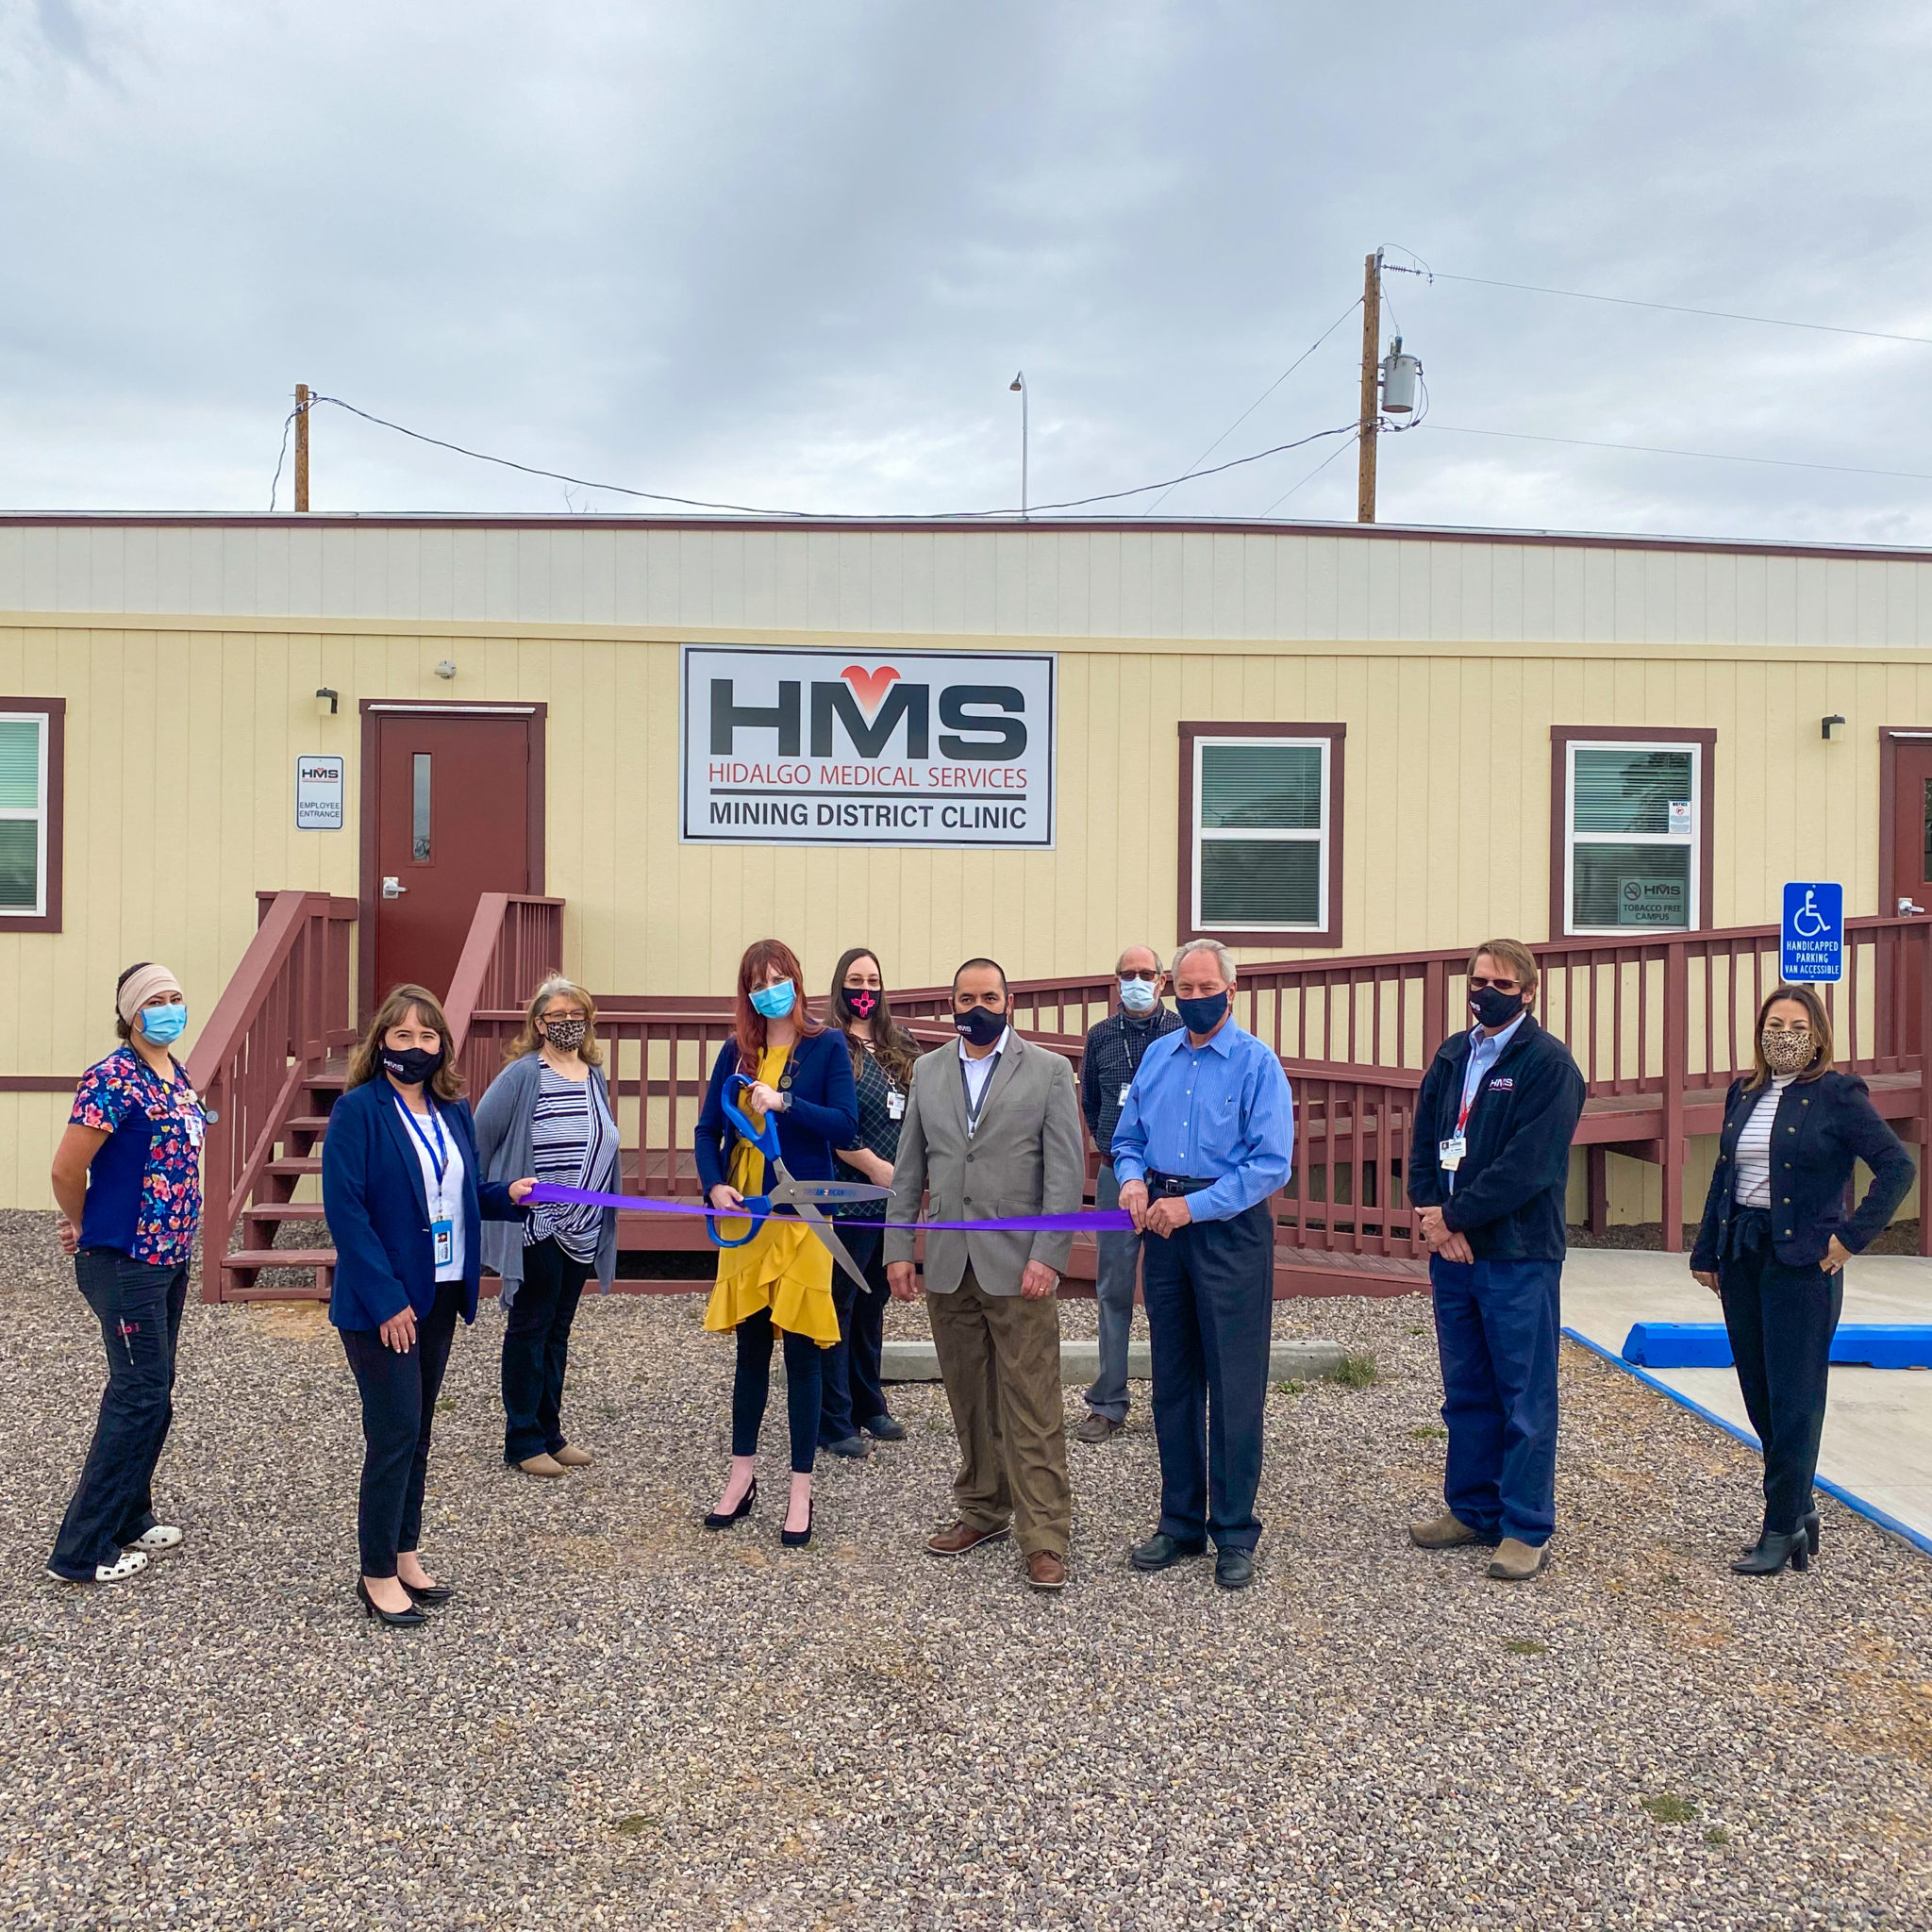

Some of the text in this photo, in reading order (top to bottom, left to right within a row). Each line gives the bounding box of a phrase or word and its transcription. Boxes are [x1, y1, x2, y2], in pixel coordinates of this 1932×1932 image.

[710, 677, 1027, 760] HMS
[302, 768, 339, 778] HMS
[708, 762, 1027, 789] HIDALGO MEDICAL SERVICES
[710, 801, 1027, 829] MINING DISTRICT CLINIC
[1644, 885, 1681, 895] HMS
[1623, 904, 1662, 912] TOBACCO
[1635, 912, 1670, 921] CAMPUS
[1786, 941, 1839, 952] HANDICAPPED
[1796, 953, 1829, 963] PARKING
[1785, 964, 1840, 974] VAN ACCESSIBLE
